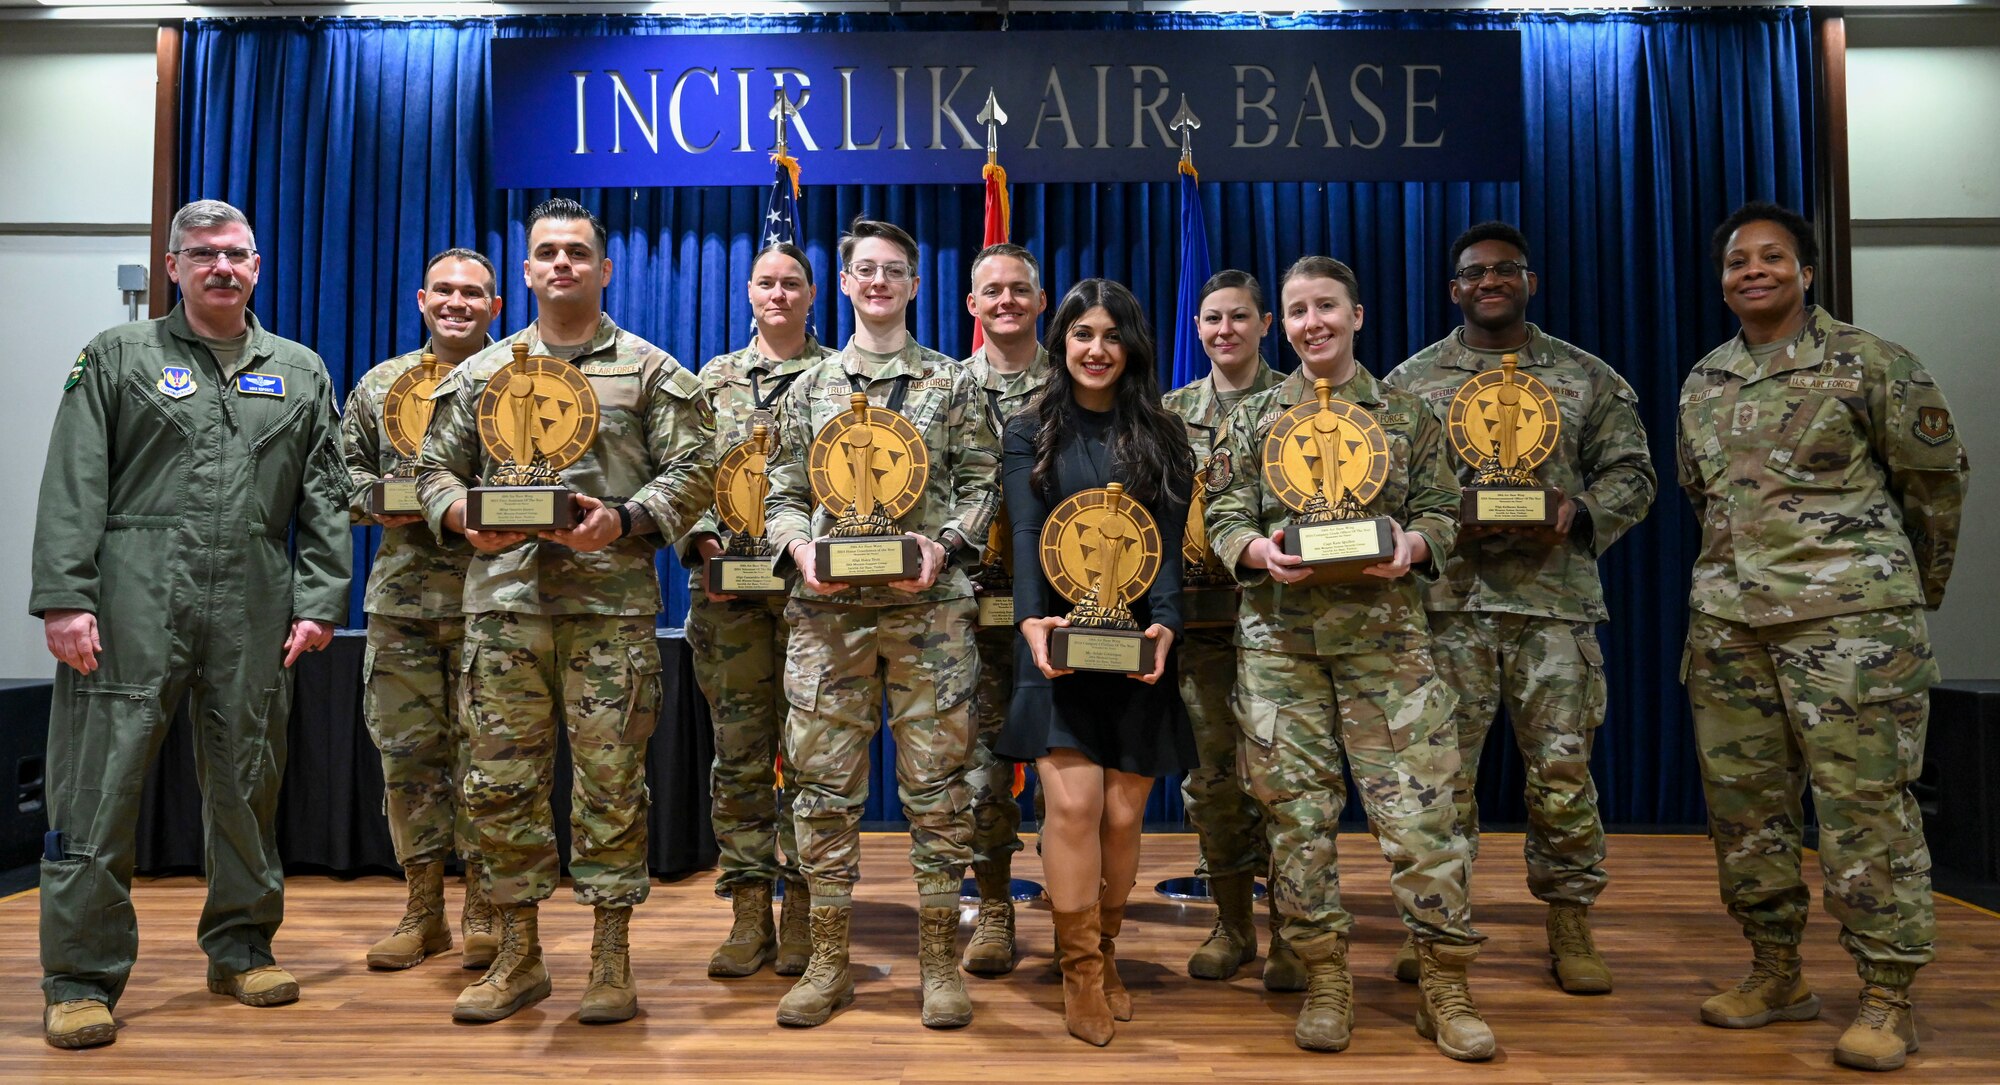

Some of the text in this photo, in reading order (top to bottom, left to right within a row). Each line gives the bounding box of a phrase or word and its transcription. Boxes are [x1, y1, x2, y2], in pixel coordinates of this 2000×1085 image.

[569, 61, 1445, 155] INCIRLIK AIR BASE
[613, 364, 637, 374] FORCE
[911, 378, 951, 389] AIR FORCE
[1827, 379, 1857, 389] FORCE
[1380, 413, 1406, 423] FORCE
